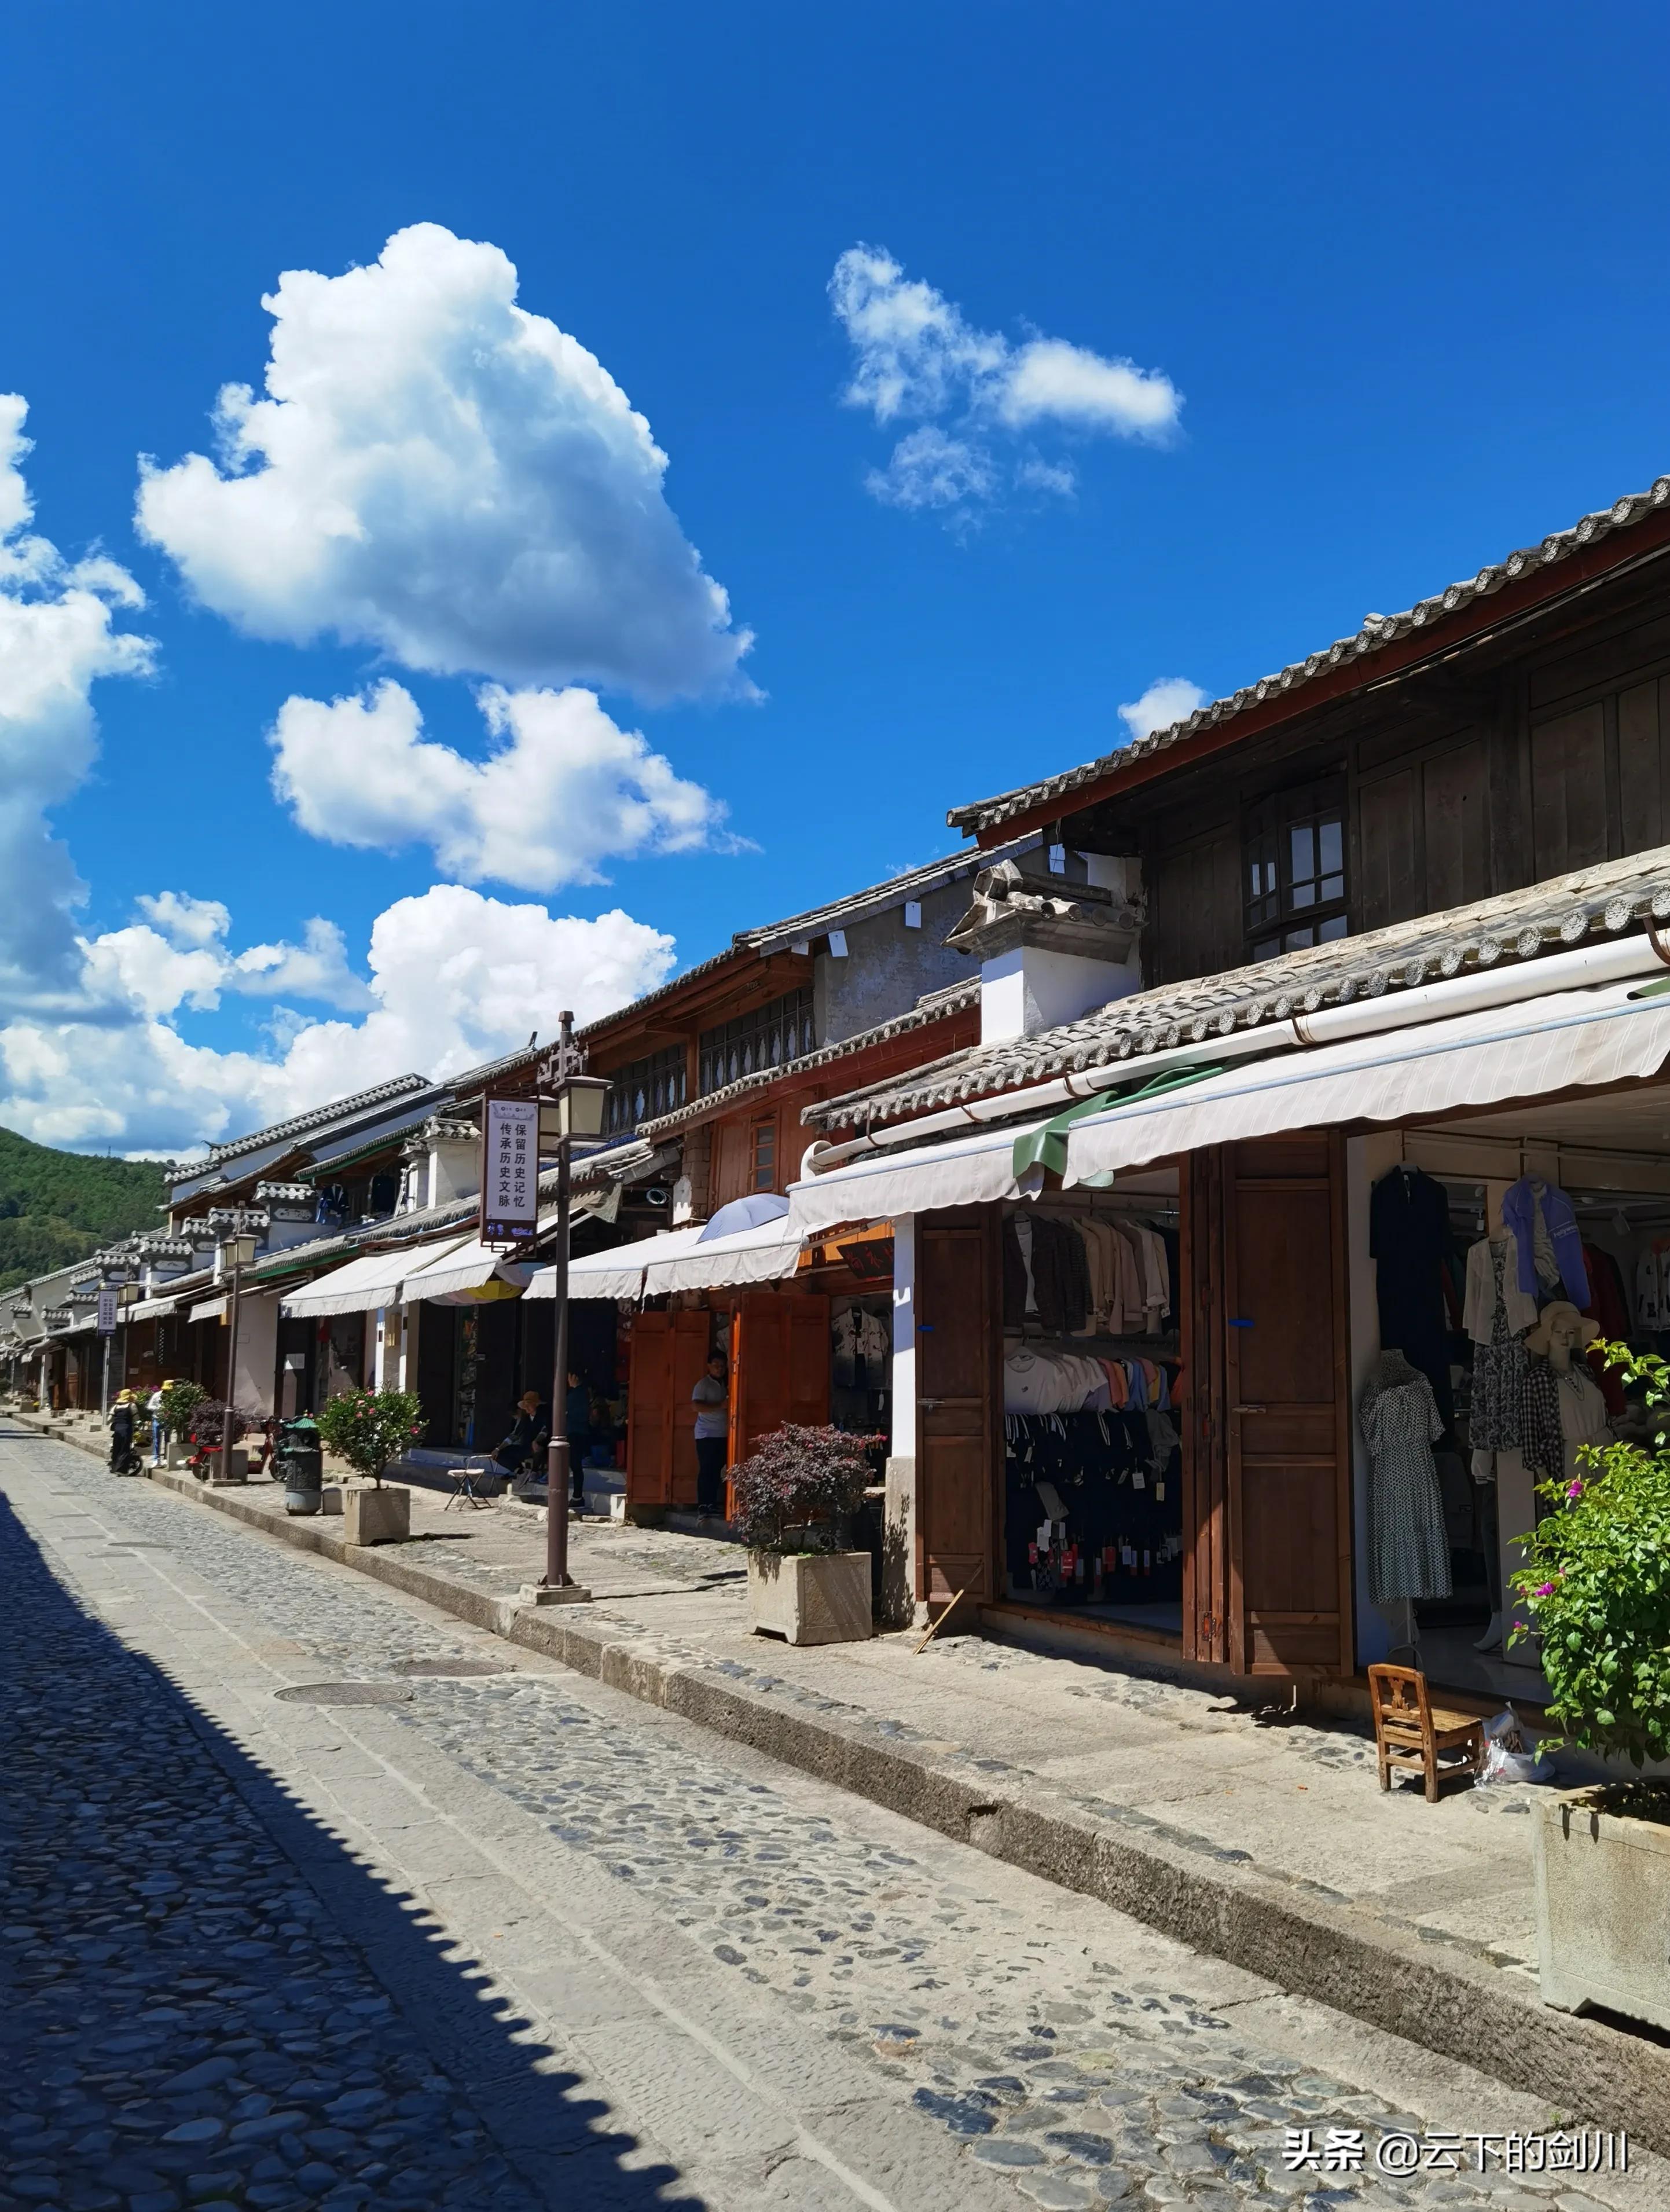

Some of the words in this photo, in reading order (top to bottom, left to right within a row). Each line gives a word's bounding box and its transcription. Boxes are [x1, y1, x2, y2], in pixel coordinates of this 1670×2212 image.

[498, 1122, 512, 1207] 传承历史文脉
[513, 1124, 527, 1208] 保留历史记忆
